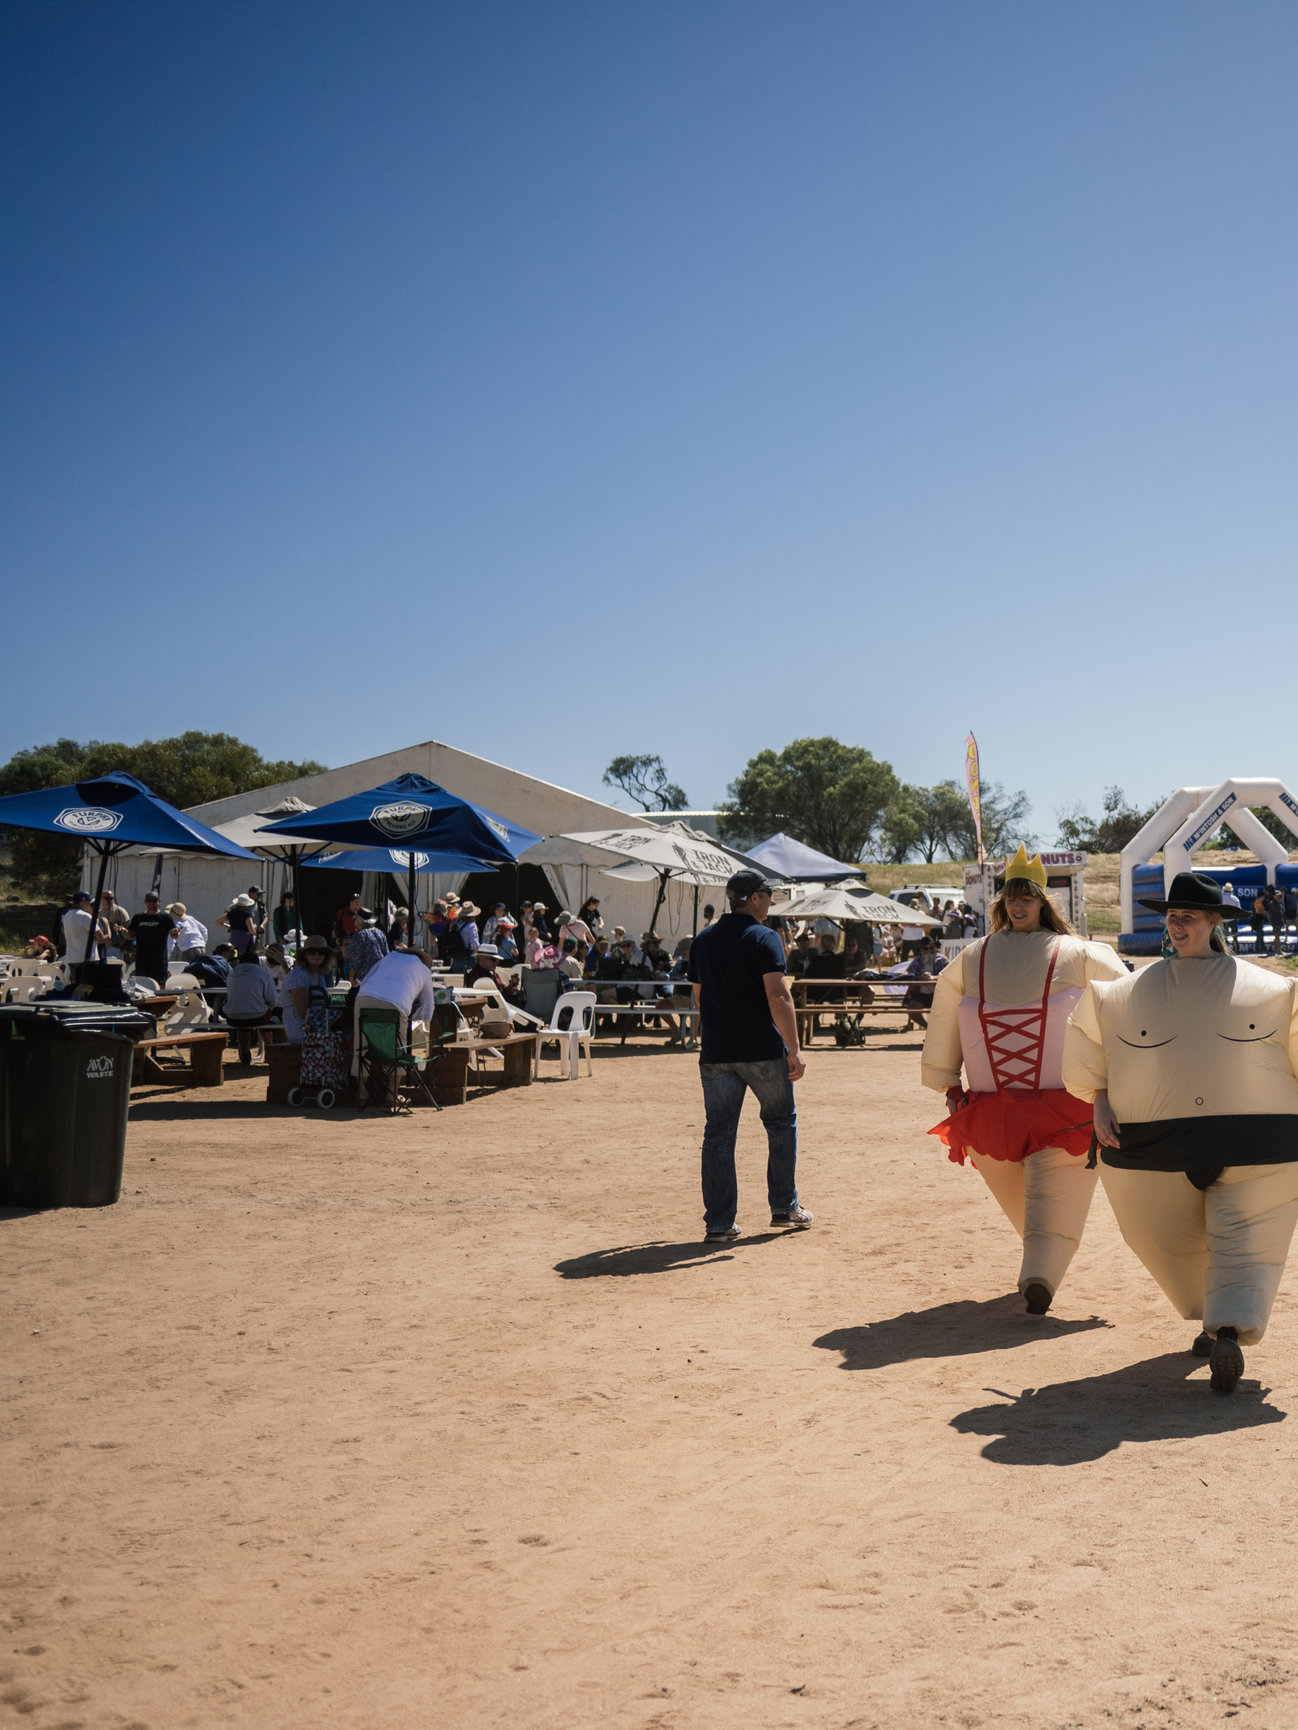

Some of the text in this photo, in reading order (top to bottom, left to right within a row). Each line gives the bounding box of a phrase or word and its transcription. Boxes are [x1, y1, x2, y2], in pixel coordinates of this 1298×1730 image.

[1222, 797, 1235, 810] SON
[692, 849, 731, 867] IRON
[699, 859, 736, 876] JACK
[1237, 888, 1258, 897] SON
[861, 905, 897, 914] IRON
[87, 1056, 114, 1071] AVON
[86, 1070, 114, 1079] WASTE
